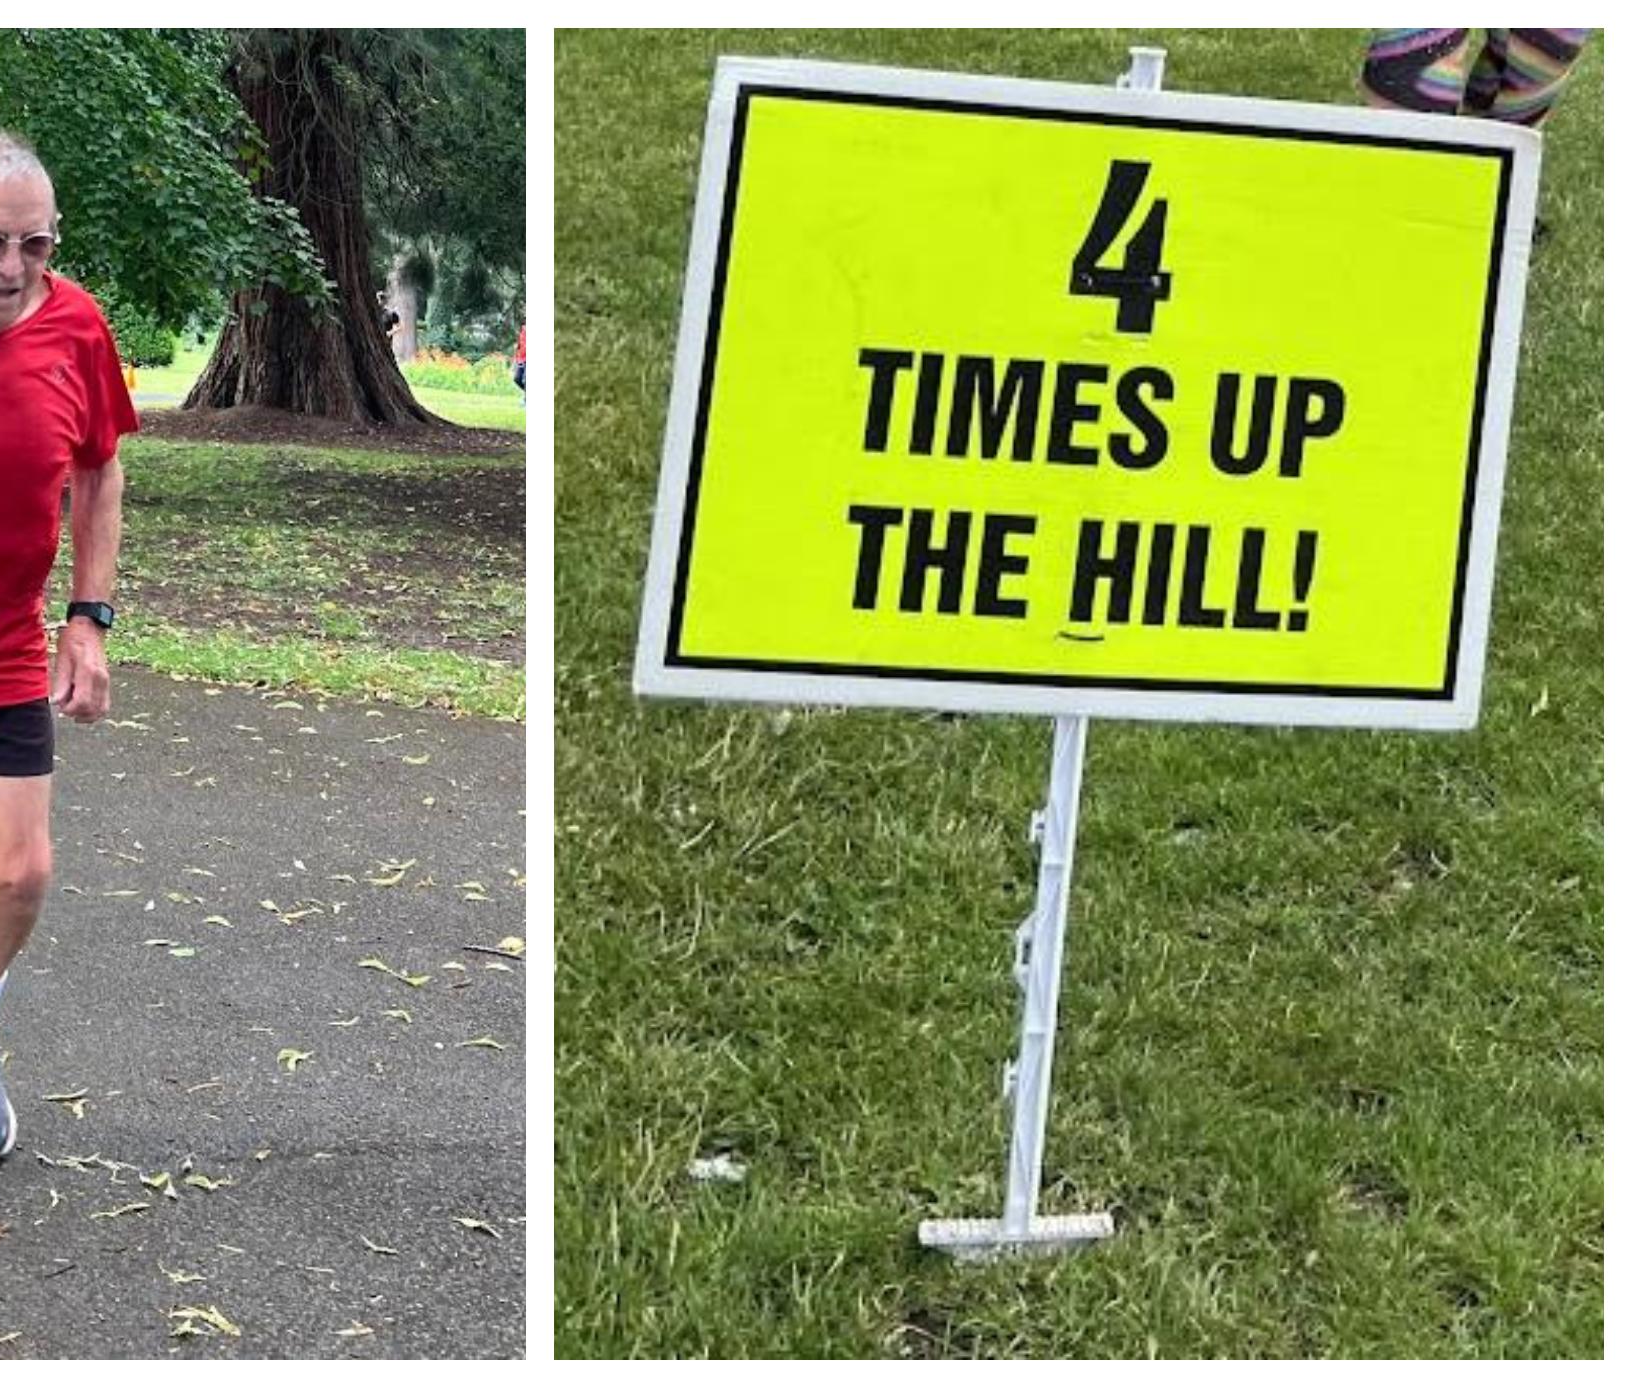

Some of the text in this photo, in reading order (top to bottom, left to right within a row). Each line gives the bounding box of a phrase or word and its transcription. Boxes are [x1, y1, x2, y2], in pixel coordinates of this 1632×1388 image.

[1069, 159, 1172, 334] 4
[858, 347, 1347, 478] TIMES UP
[847, 504, 1319, 633] THE HILL!
